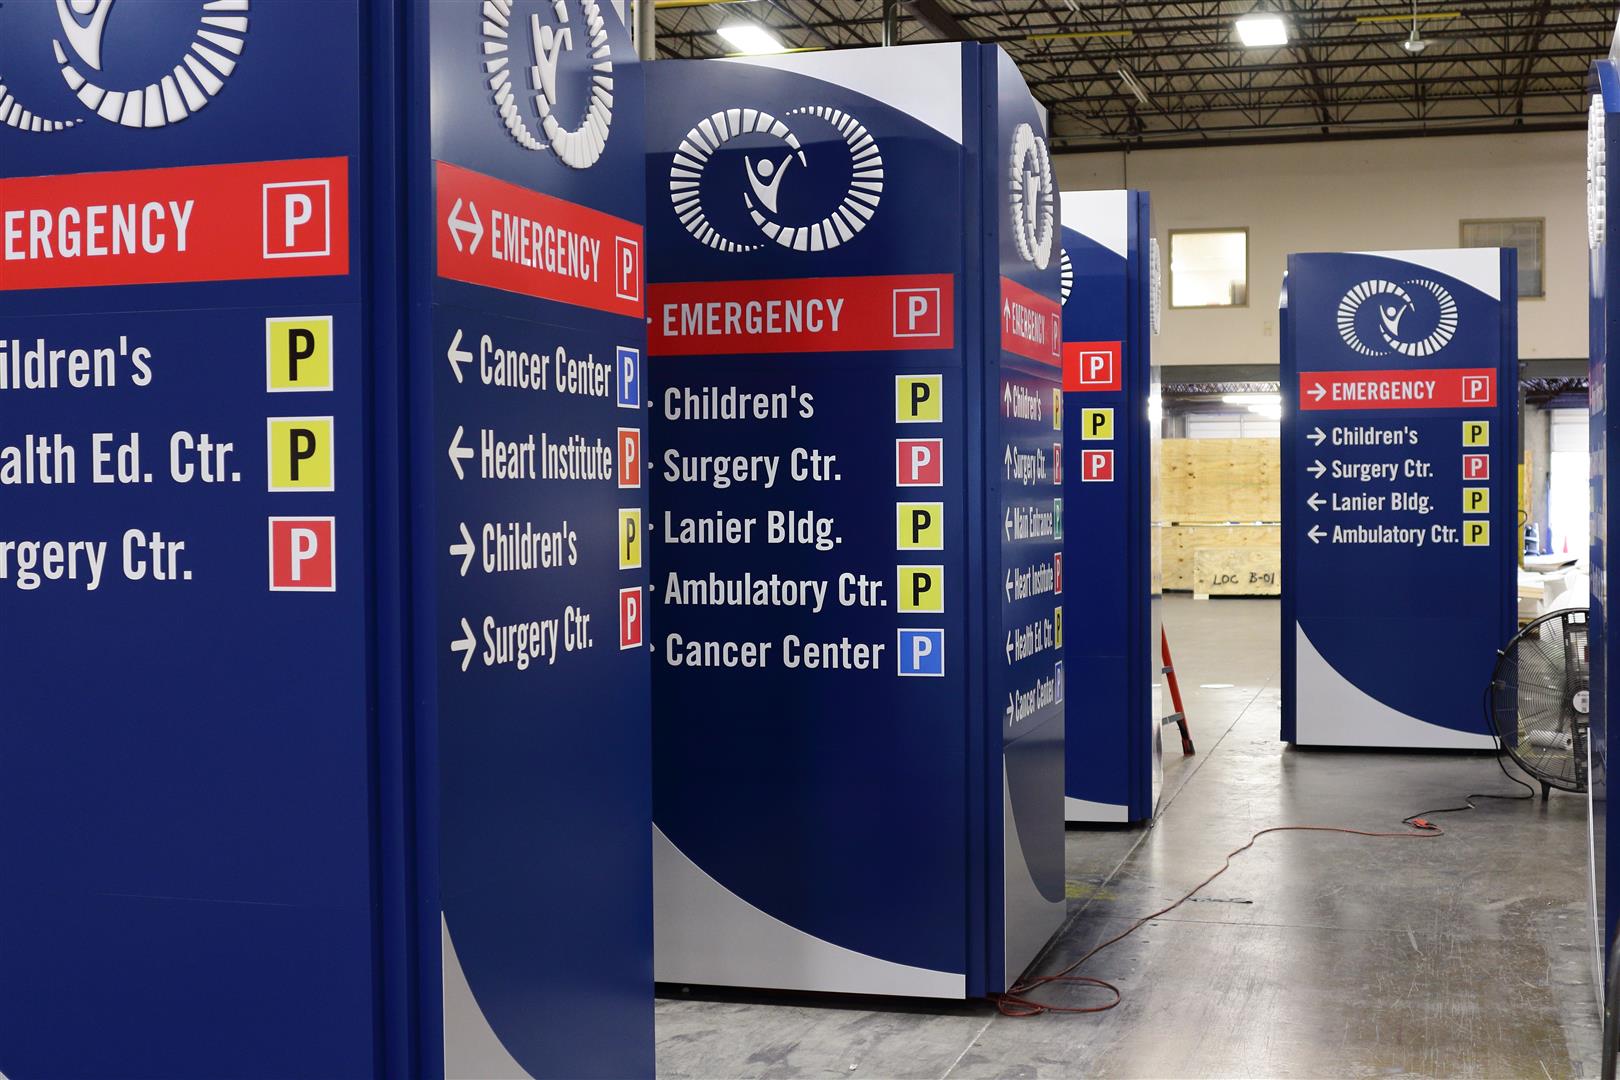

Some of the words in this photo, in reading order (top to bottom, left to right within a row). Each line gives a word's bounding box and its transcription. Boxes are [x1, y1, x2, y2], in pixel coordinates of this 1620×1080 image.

[285, 194, 312, 247] P
[491, 209, 600, 283] EMERGENCY
[623, 248, 633, 290] P
[664, 298, 844, 337] EMERGENCY
[908, 296, 928, 330] P
[1012, 302, 1045, 344] EMERGENCY
[288, 328, 315, 381] P
[480, 334, 550, 390] Cancer
[555, 346, 611, 398] Center
[624, 357, 634, 397] P
[1090, 356, 1104, 379] P
[665, 385, 814, 420] Children's
[911, 382, 930, 416] P
[1013, 385, 1041, 421] Children's
[1332, 381, 1435, 401] EMERGENCY
[1471, 380, 1482, 398] P
[1093, 414, 1105, 435] P
[1332, 426, 1418, 445] Children's
[1472, 426, 1482, 443] P
[92, 432, 152, 483] Ed.
[170, 431, 241, 483] Ctr.
[290, 429, 316, 481] P
[481, 429, 535, 479] Heart
[542, 432, 612, 480] Institute
[625, 438, 635, 478] P
[664, 449, 779, 488] Surgery
[790, 447, 841, 481] Ctr.
[912, 446, 931, 480] P
[1014, 446, 1036, 485] Surgery
[1037, 448, 1046, 479] Ctr.
[1092, 455, 1105, 477] P
[1332, 460, 1398, 481] Surgery
[1405, 459, 1433, 477] Ctr.
[1471, 459, 1482, 476] P
[1332, 493, 1385, 511] Lanier
[1391, 493, 1434, 513] Bldg.
[1472, 492, 1482, 509] P
[665, 511, 756, 544] Lanier
[767, 510, 842, 550] Bldg.
[912, 510, 931, 543] P
[1015, 507, 1028, 539] Main
[1029, 508, 1052, 536] Entrance
[1332, 526, 1425, 546] Ambulatory
[1432, 525, 1459, 543] Ctr.
[1472, 525, 1482, 542] P
[122, 529, 192, 580] Ctr.
[291, 528, 318, 581] P
[483, 521, 577, 573] Children's
[626, 518, 636, 561] P
[665, 572, 828, 612] Ambulatory
[838, 572, 887, 606] Ctr.
[912, 573, 932, 606] P
[1015, 567, 1031, 600] Heart
[1032, 563, 1053, 595] Institute
[1213, 575, 1239, 585] LOC
[1249, 572, 1274, 584] B-01
[483, 612, 558, 670] Surgery
[564, 605, 593, 651] Ctr.
[627, 597, 637, 640] P
[666, 633, 771, 667] Cancer
[783, 635, 885, 669] Center
[913, 636, 932, 669] P
[1015, 625, 1033, 661] Health
[1035, 620, 1043, 650] Ed.
[1015, 686, 1035, 722] Cancer
[1037, 677, 1054, 709] Center
